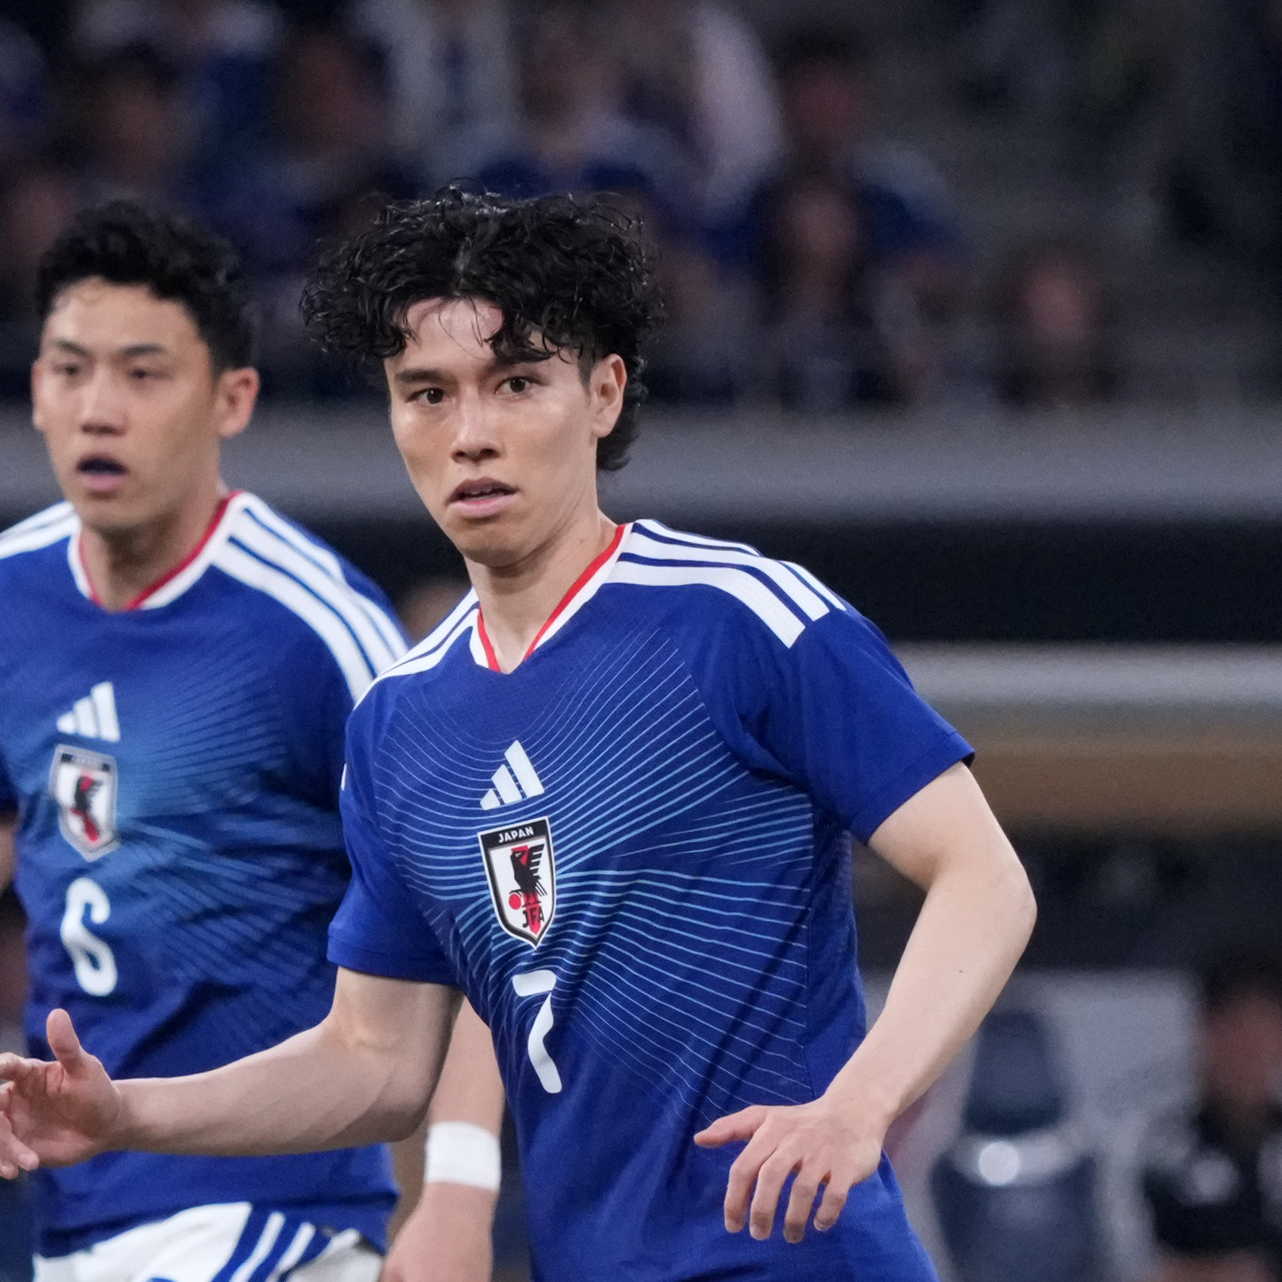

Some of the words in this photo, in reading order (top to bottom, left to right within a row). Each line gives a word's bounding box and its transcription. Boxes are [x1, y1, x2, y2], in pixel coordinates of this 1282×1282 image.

[498, 826, 534, 843] JAPAN
[60, 877, 118, 996] 6
[522, 905, 544, 928] JFA
[512, 969, 562, 1094] 7
